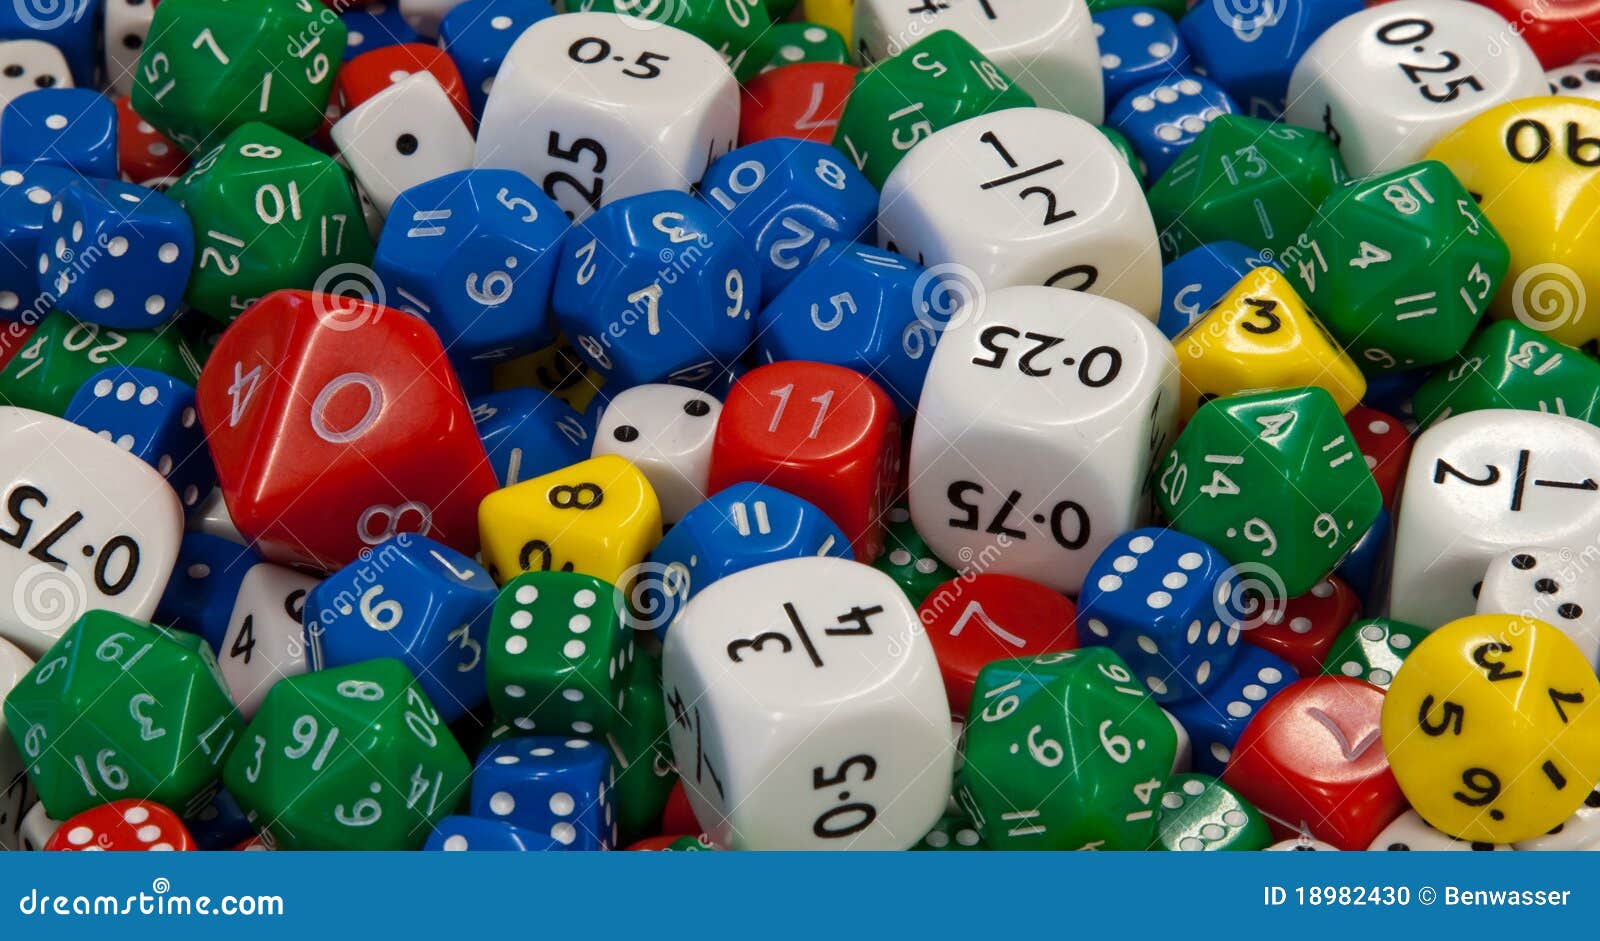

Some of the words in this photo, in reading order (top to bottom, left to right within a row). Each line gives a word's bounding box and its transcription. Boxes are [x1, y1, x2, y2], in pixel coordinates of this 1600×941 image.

[192, 28, 229, 64] 7
[912, 52, 947, 77] 5
[144, 51, 176, 101] 15
[259, 72, 272, 112] 1
[970, 59, 1009, 92] 18
[888, 102, 933, 150] 15
[240, 143, 281, 159] 8
[1221, 145, 1267, 185] 13
[710, 160, 765, 211] 10
[815, 159, 846, 190] 8
[255, 180, 302, 224] 10
[496, 187, 538, 222] 5
[1383, 177, 1434, 215] 18
[320, 214, 347, 256] 17
[407, 209, 452, 237] 11
[652, 213, 698, 243] 3
[1255, 198, 1274, 239] 1
[200, 230, 245, 276] 12
[575, 239, 596, 285] 2
[856, 251, 907, 270] 11
[1350, 241, 1391, 268] 4
[1395, 291, 1438, 321] 11
[1461, 263, 1491, 314] 13
[627, 284, 663, 335] 7
[810, 292, 857, 331] 5
[1241, 298, 1281, 335] 3
[16, 335, 49, 380] 14
[63, 323, 128, 363] 20
[1508, 340, 1563, 376] 13
[228, 360, 262, 428] 4
[310, 371, 387, 443] 0
[767, 383, 835, 441] 11
[1255, 411, 1296, 438] 4
[549, 482, 603, 510] 8
[1160, 450, 1187, 506] 20
[1200, 454, 1244, 499] 14
[733, 501, 771, 536] 11
[229, 613, 256, 664] 4
[949, 600, 1026, 648] 7
[448, 623, 481, 671] 3
[1473, 641, 1523, 683] 3
[336, 680, 385, 701] 8
[983, 679, 1022, 722] 19
[1548, 687, 1584, 724] 7
[129, 693, 166, 741] 3
[405, 687, 439, 748] 20
[1418, 695, 1464, 736] 5
[75, 748, 129, 797] 16
[246, 735, 266, 783] 3
[407, 763, 444, 816] 14
[1126, 777, 1161, 822] 14
[1001, 810, 1046, 837] 11
